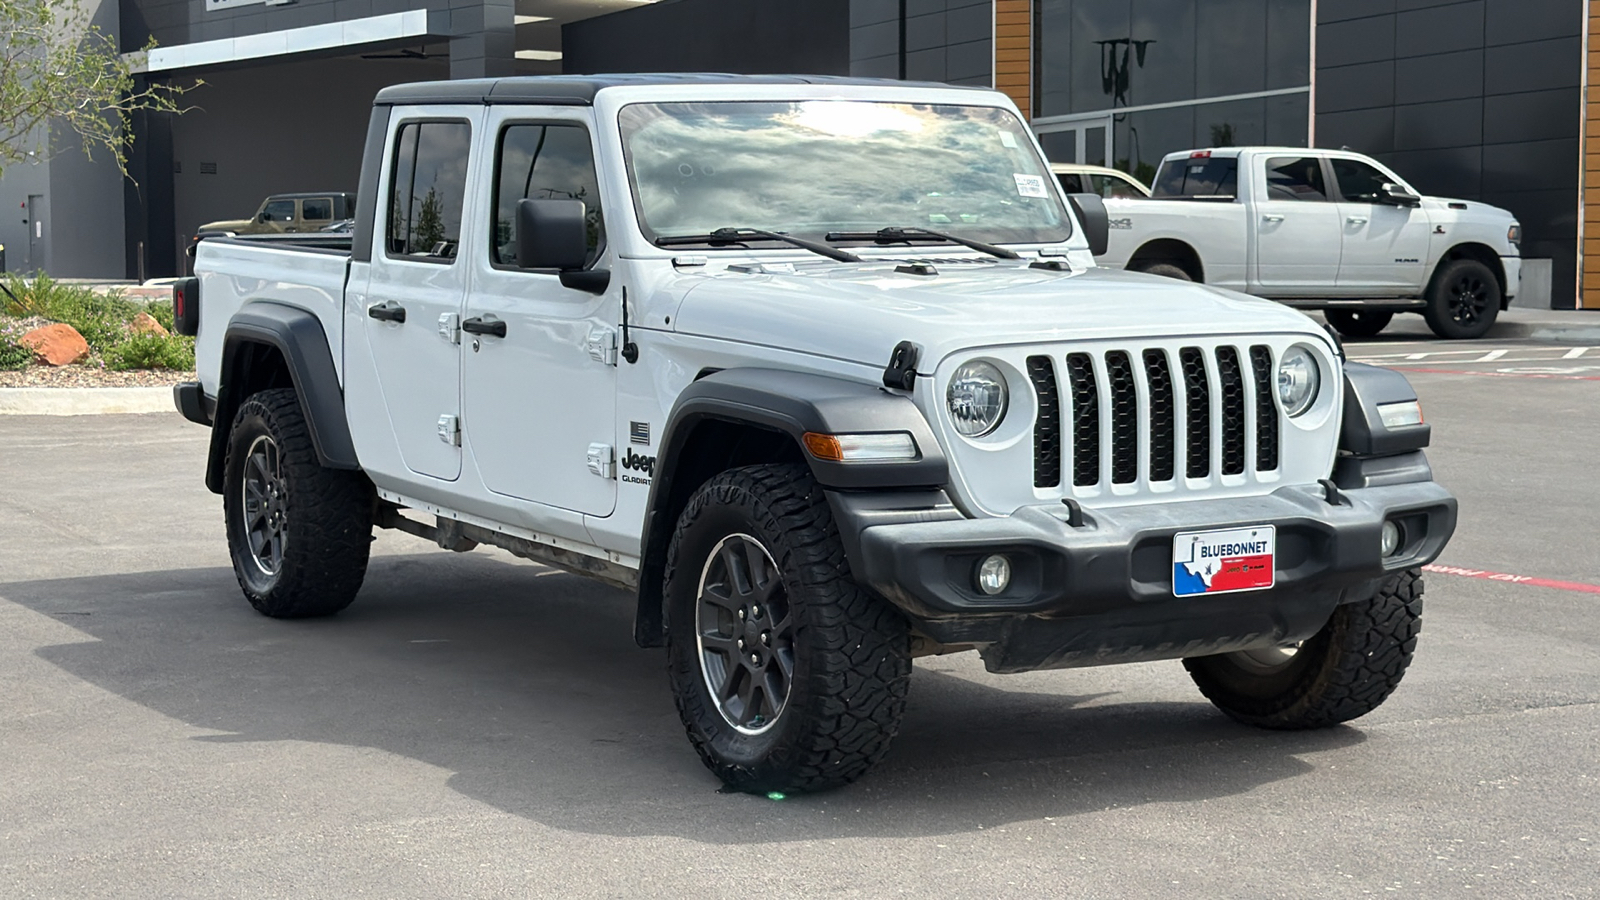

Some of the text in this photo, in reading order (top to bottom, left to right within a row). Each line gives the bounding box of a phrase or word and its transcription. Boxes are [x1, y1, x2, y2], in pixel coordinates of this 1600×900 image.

[622, 447, 656, 477] Jeep
[622, 475, 651, 485] GLADIAT
[1201, 541, 1267, 558] BLUEBONNET
